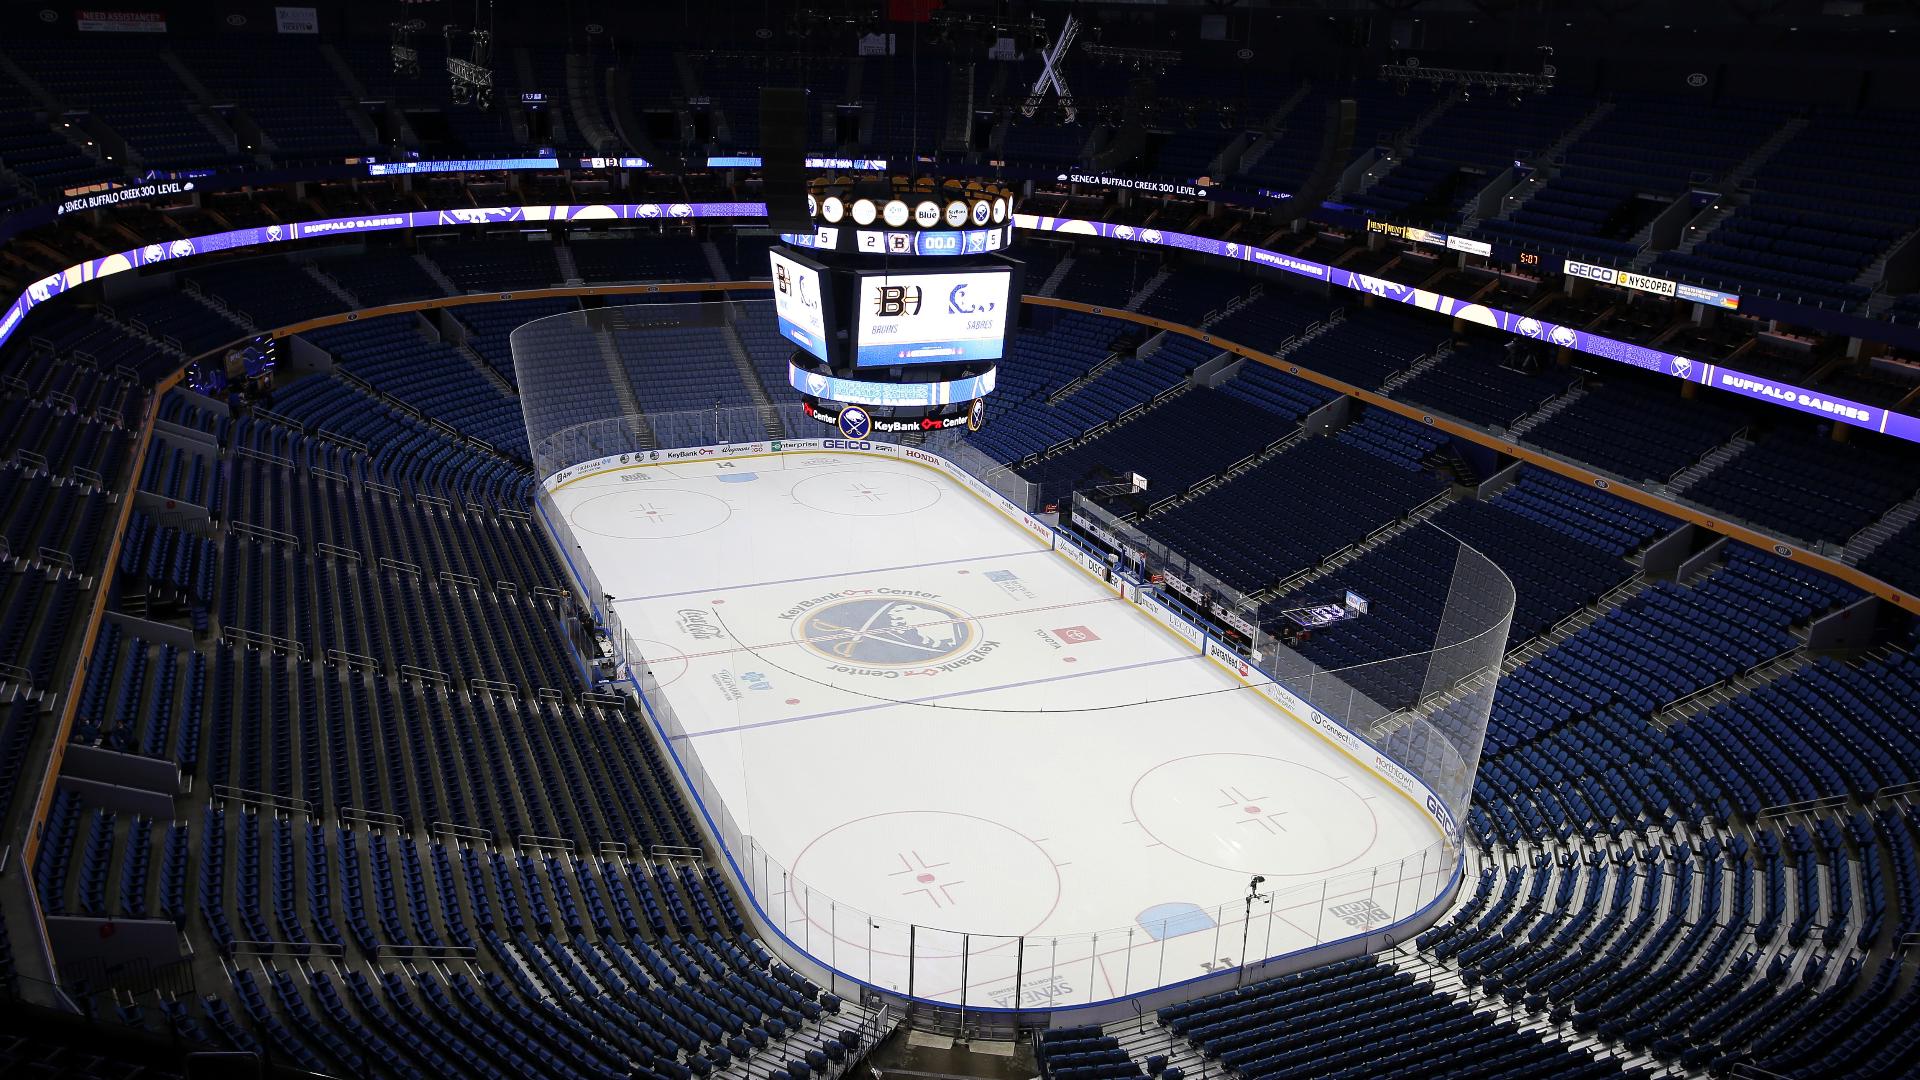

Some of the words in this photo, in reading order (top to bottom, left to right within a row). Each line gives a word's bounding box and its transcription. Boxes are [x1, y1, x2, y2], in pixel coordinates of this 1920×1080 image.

[1070, 174, 1099, 184] SENECA
[1101, 177, 1133, 188] BUFFALO
[1134, 180, 1157, 191] CREEK
[1159, 183, 1174, 193] 300
[1176, 185, 1195, 196] LEVEL
[64, 198, 88, 213] SENECA
[89, 192, 119, 207] BUFFALO
[120, 188, 140, 200] CREEK
[140, 185, 155, 196] 300
[158, 183, 181, 195] LEVEL
[919, 211, 937, 219] Blue
[304, 221, 354, 234] BUFFALO
[356, 217, 403, 228] SABRES
[1371, 221, 1386, 230] HUNT
[821, 233, 828, 243] 5
[867, 236, 876, 247] 2
[925, 236, 956, 250] 00.0
[1255, 251, 1290, 268] BUFFALO
[1290, 260, 1323, 276] SABRES
[1521, 252, 1538, 265] 5:07
[1568, 262, 1613, 281] GEICO
[1628, 275, 1673, 294] NYSCOPBA
[871, 324, 898, 335] BRUINS
[966, 320, 993, 330] SABRES
[1722, 374, 1797, 401] BUFFALO
[1798, 395, 1870, 422] SABRES
[813, 410, 837, 425] Center
[874, 421, 920, 432] KeyBank
[942, 416, 969, 427] Center
[823, 439, 871, 451] GEICO
[667, 450, 698, 459] KeyBank
[905, 449, 940, 466] HONDA
[1088, 559, 1119, 588] DISCER
[778, 592, 844, 620] KeyBank
[876, 587, 942, 601] Center
[1034, 628, 1062, 650] TOYOTA
[941, 639, 1001, 674] KeyBank
[826, 663, 900, 679] Center
[1375, 755, 1415, 789] northtown
[987, 987, 1017, 997] ASINOS
